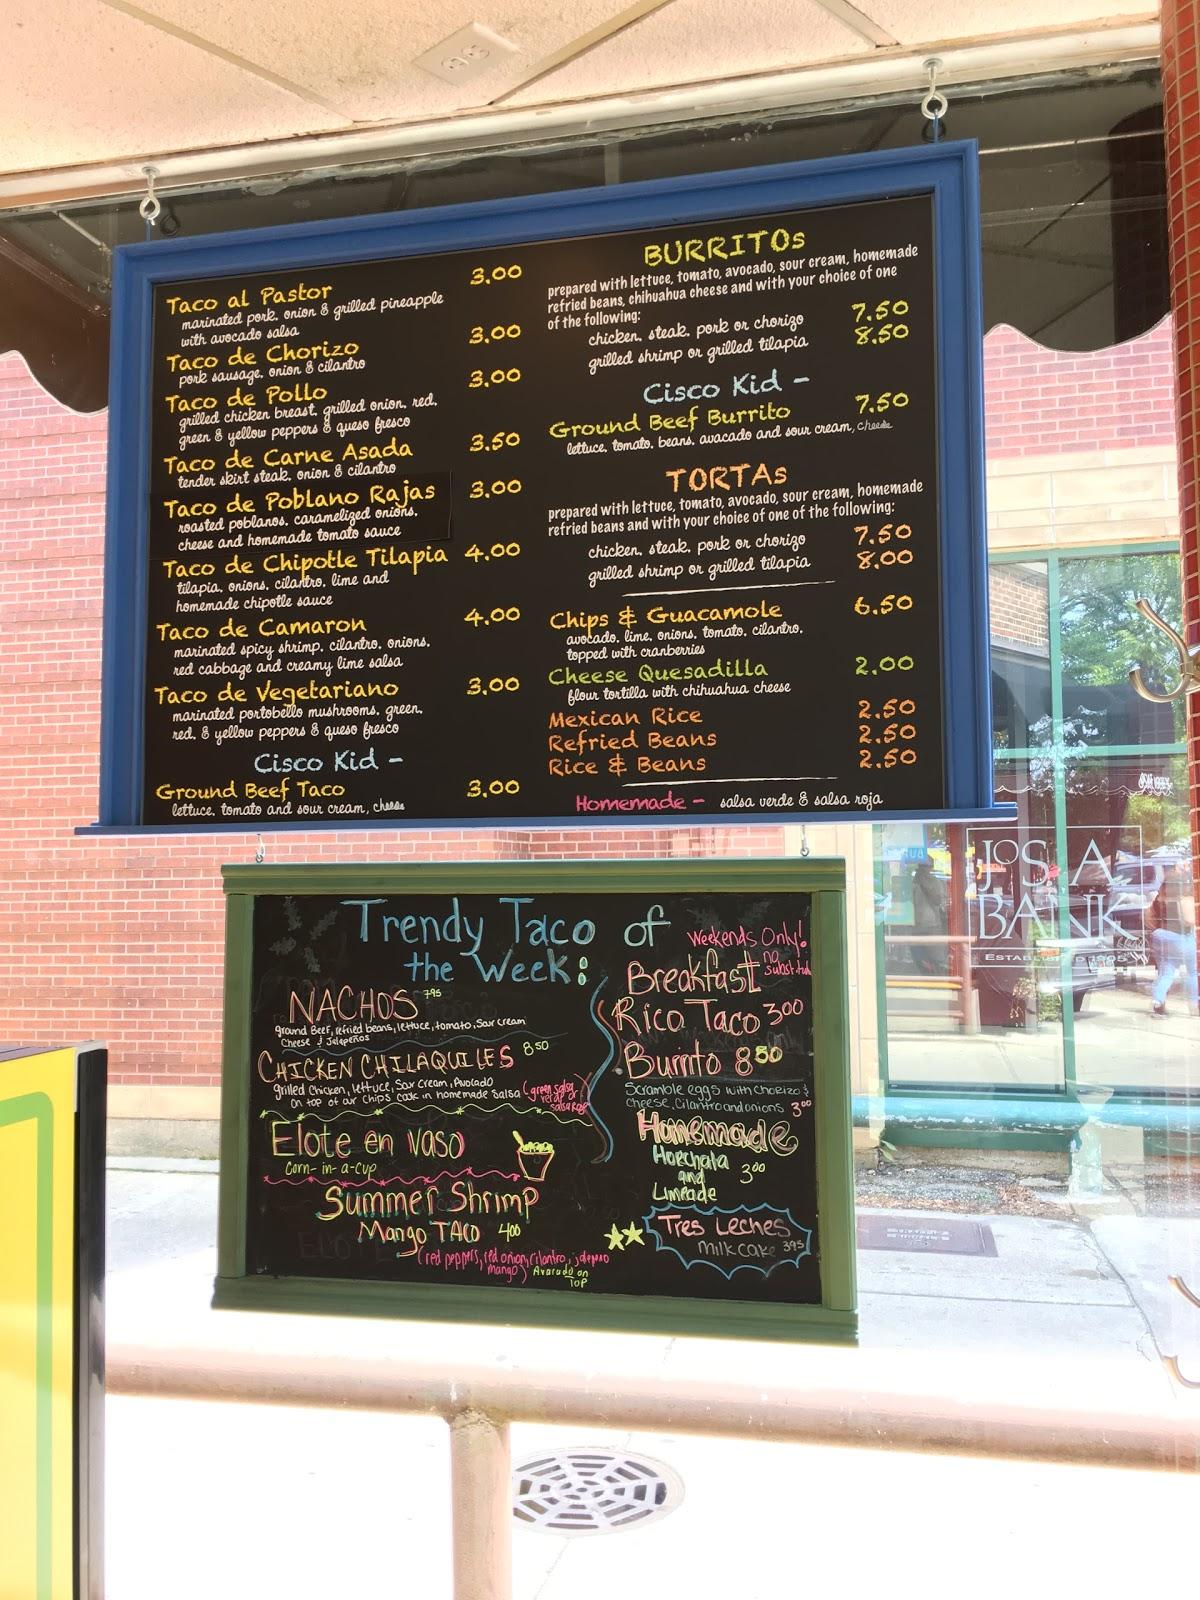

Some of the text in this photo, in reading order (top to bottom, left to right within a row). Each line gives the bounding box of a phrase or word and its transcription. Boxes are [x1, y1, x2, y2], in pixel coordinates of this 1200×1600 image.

[470, 265, 522, 285] 3.00
[548, 244, 918, 300] prepared with lettuce, tomato, avocado, sour cream, homemade
[166, 283, 332, 316] Taco al Pastor
[548, 263, 897, 314] refried beans, chihuahua cheese and with your choice of one
[548, 308, 640, 330] of the following:
[852, 301, 908, 322] 7.50
[182, 325, 299, 347] with avocado salsa
[469, 324, 521, 344] 3.00
[854, 324, 909, 345] 8.50
[166, 341, 359, 372] Taco de Chorizo
[469, 368, 521, 388] 3.00
[643, 369, 782, 404] Cisco Kid
[166, 383, 328, 413] Taco de Pollo
[550, 393, 909, 437] Ground Beef Burrito 7.50
[164, 432, 520, 474] Taco de Carne Asada 3.50
[164, 480, 522, 519] Taco de Poblano Rajas 3.00
[854, 524, 912, 545] 7.50
[163, 543, 520, 579] Taco de Chipotle Tilapia 4.00
[857, 550, 913, 569] 8.00
[176, 594, 332, 612] homemade chipotle sauce
[550, 595, 913, 637] Chips & Guacamole 6.50
[157, 607, 520, 641] Taco de Camaron 4.00
[567, 643, 705, 662] topped with cranberries
[549, 656, 913, 685] Cheese Quesadilla 2.00
[155, 677, 520, 706] Taco de Vegetariano 3.00
[549, 699, 915, 729] Mexican Rice 2.50
[549, 724, 916, 754] Refried Beans 2.50
[254, 748, 379, 773] Cisco Kid
[549, 749, 917, 776] Rice & Beans 2.50
[156, 778, 520, 802] Ground Beef Taco 3.00
[576, 791, 882, 812] Homemade salsa verde & salsa roja
[1069, 838, 1118, 886] A
[340, 897, 595, 956] Trendy Taco
[624, 904, 671, 947] of
[976, 892, 1138, 940] BANK
[762, 920, 807, 957] Only!
[404, 952, 454, 982] the
[627, 948, 761, 994] Breakfast
[290, 985, 418, 1023] NACHOS
[612, 997, 684, 1036] Rico
[684, 999, 761, 1036] Taco
[275, 1025, 307, 1037] ground
[335, 1024, 363, 1036] refried
[361, 1045, 514, 1079] CHILAQUILES
[624, 1039, 721, 1079] Burrito
[625, 1082, 752, 1101] Scramble eggs with
[273, 1121, 352, 1157] Elote
[364, 1132, 393, 1155] en
[637, 1109, 799, 1157] Homemade
[678, 1168, 705, 1185] and
[316, 1182, 539, 1224] Summer Shrimp
[358, 1221, 427, 1258] Mango
[658, 1215, 791, 1237] Tres Leches
